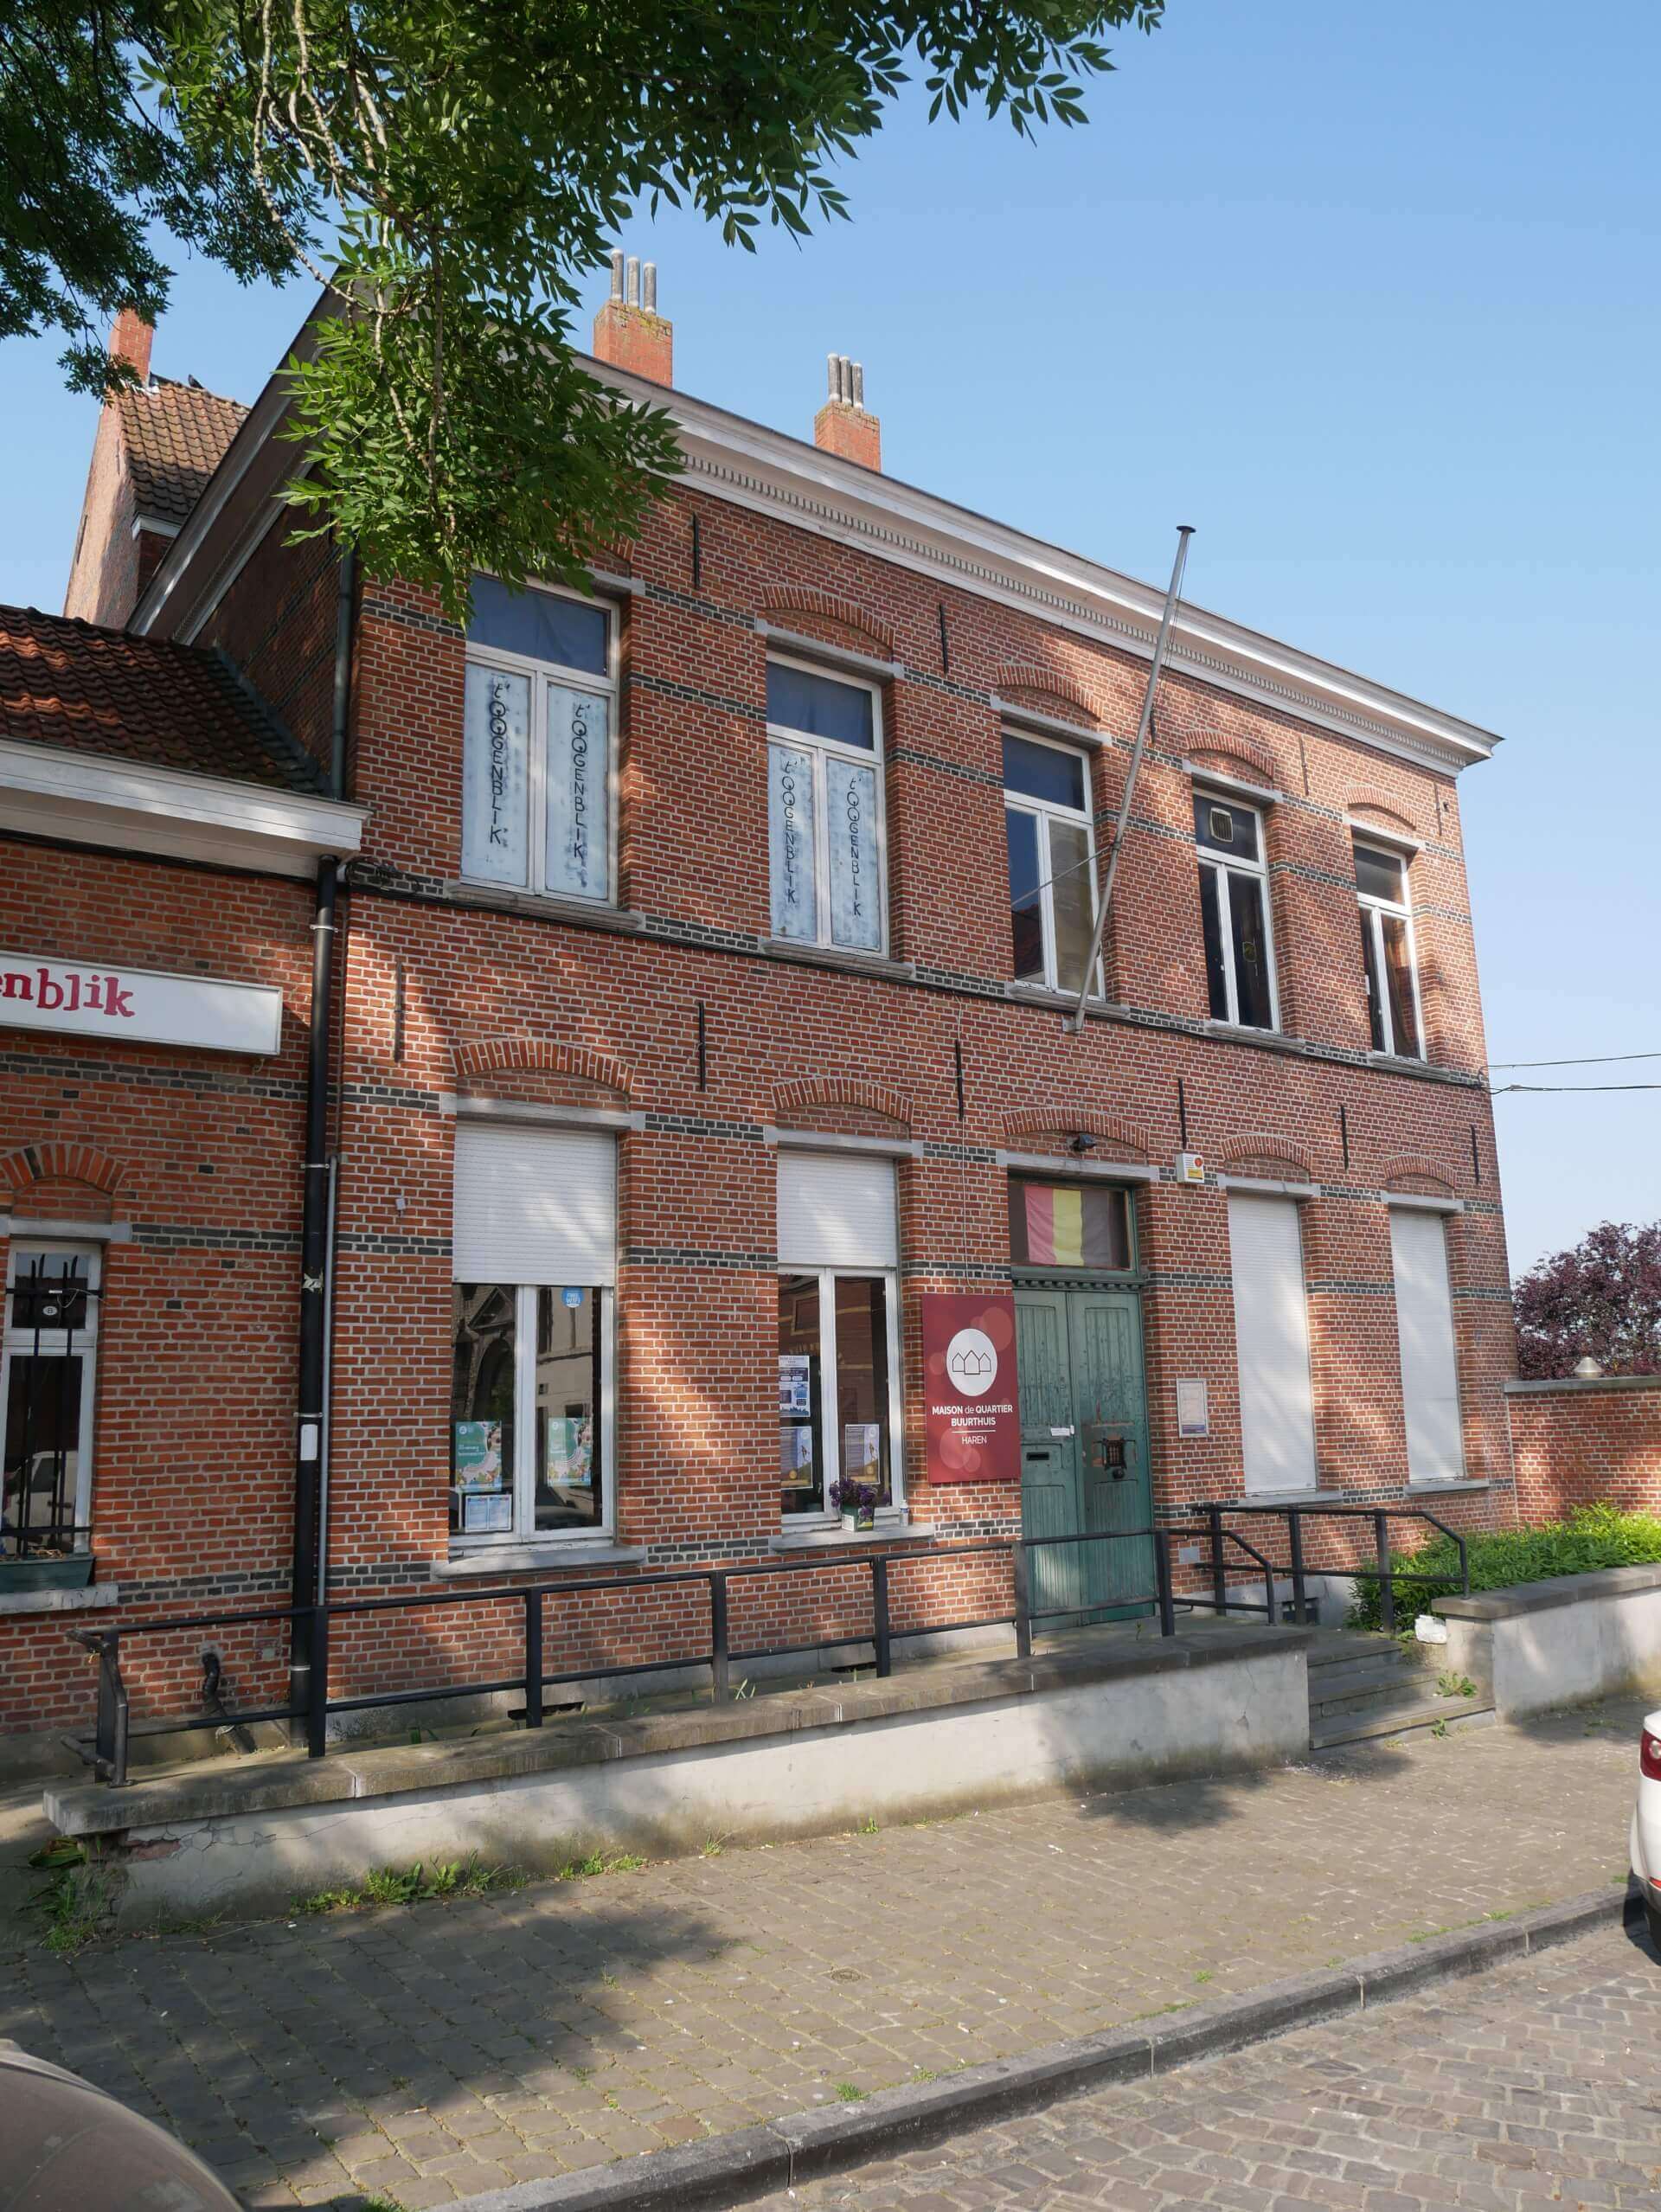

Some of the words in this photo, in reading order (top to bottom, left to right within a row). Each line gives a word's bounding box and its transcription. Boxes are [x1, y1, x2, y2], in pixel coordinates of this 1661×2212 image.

[0, 968, 135, 1017] nblik
[932, 1406, 963, 1415] MAISON
[975, 1404, 1013, 1414] QUARTIER
[951, 1417, 996, 1427] BUURTHUIS
